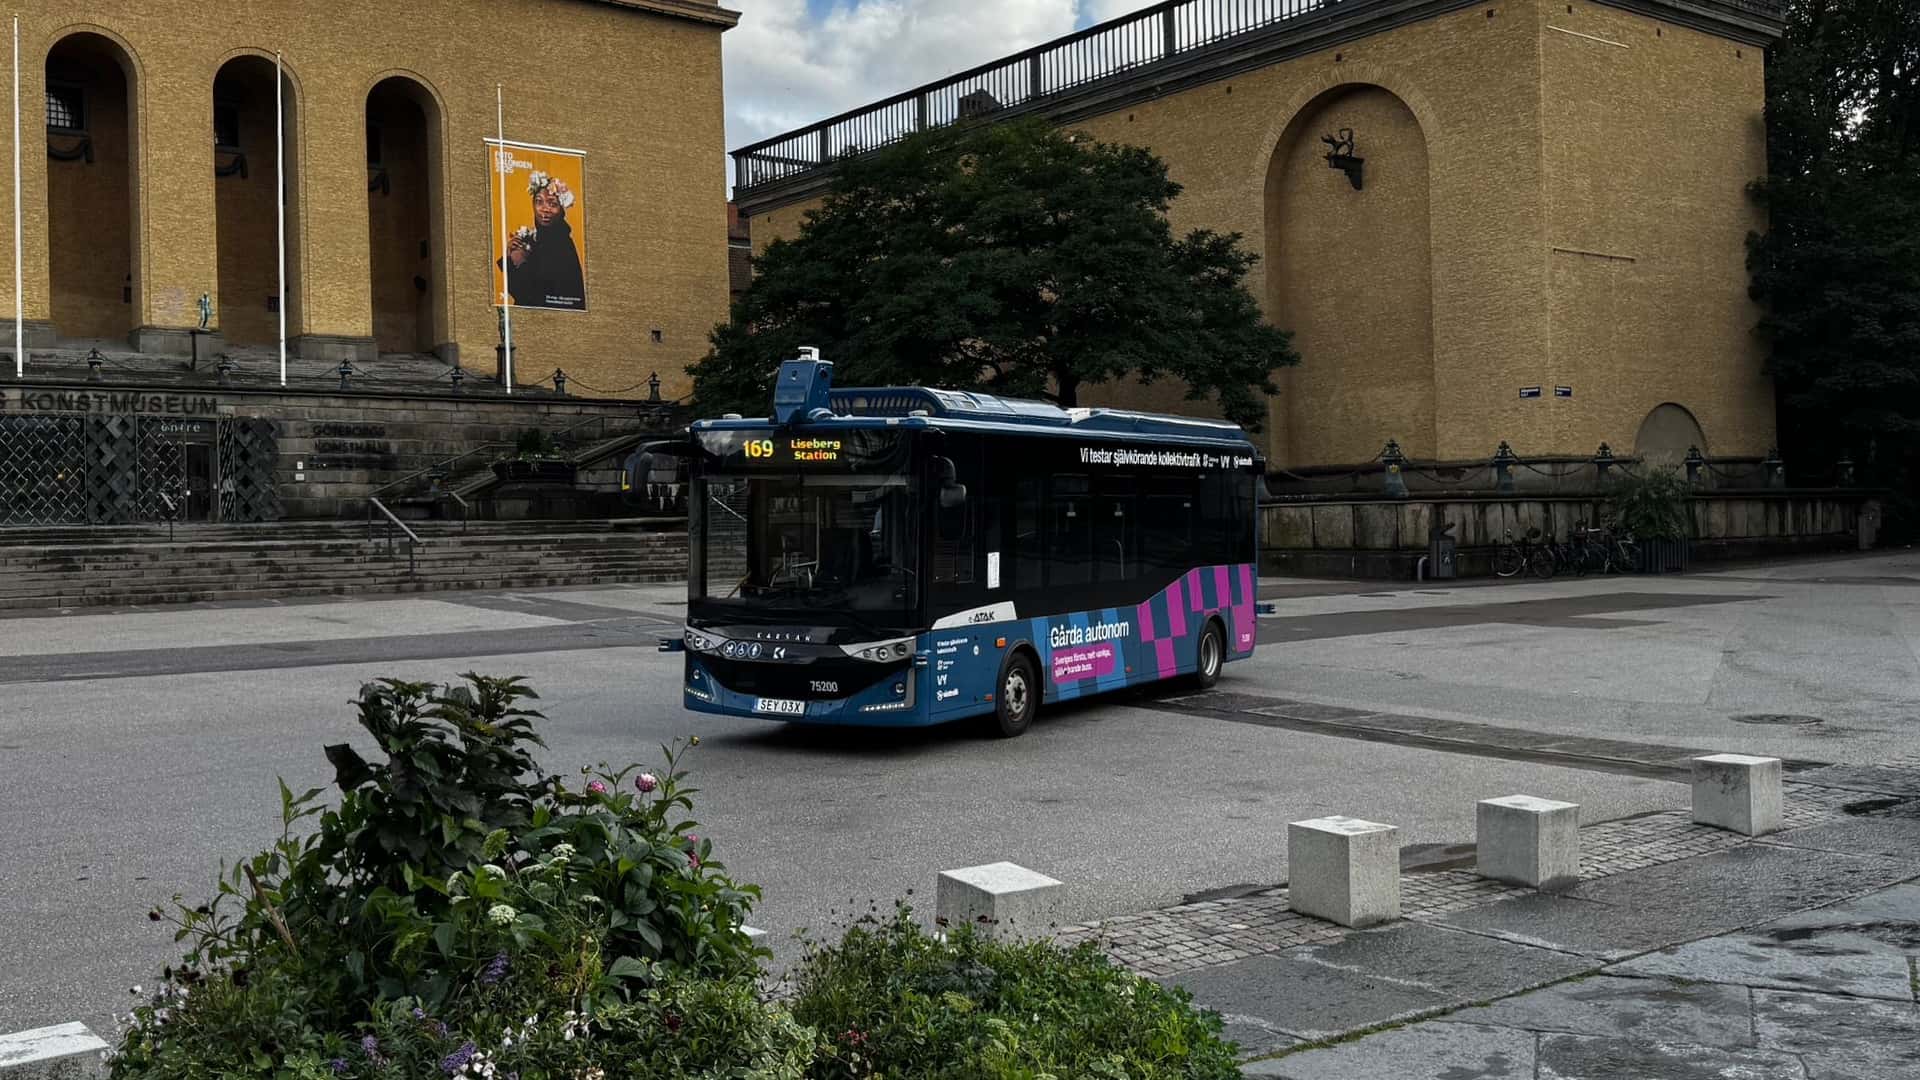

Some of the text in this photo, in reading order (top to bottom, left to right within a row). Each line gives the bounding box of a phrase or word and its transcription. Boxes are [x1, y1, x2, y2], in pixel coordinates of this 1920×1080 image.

[495, 151, 512, 162] FTO
[20, 392, 218, 415] KONSTMUSEUM
[743, 439, 774, 458] 169
[791, 438, 841, 450] Liseberg
[794, 449, 837, 460] Station
[1080, 447, 1088, 463] Vi
[1090, 447, 1112, 464] testar
[1113, 448, 1158, 467] självkörande
[1158, 450, 1201, 467] kollektivtrafik
[1050, 621, 1129, 648] Gårda autonom
[809, 680, 838, 692] 75200
[760, 699, 801, 713] SEY 03X
